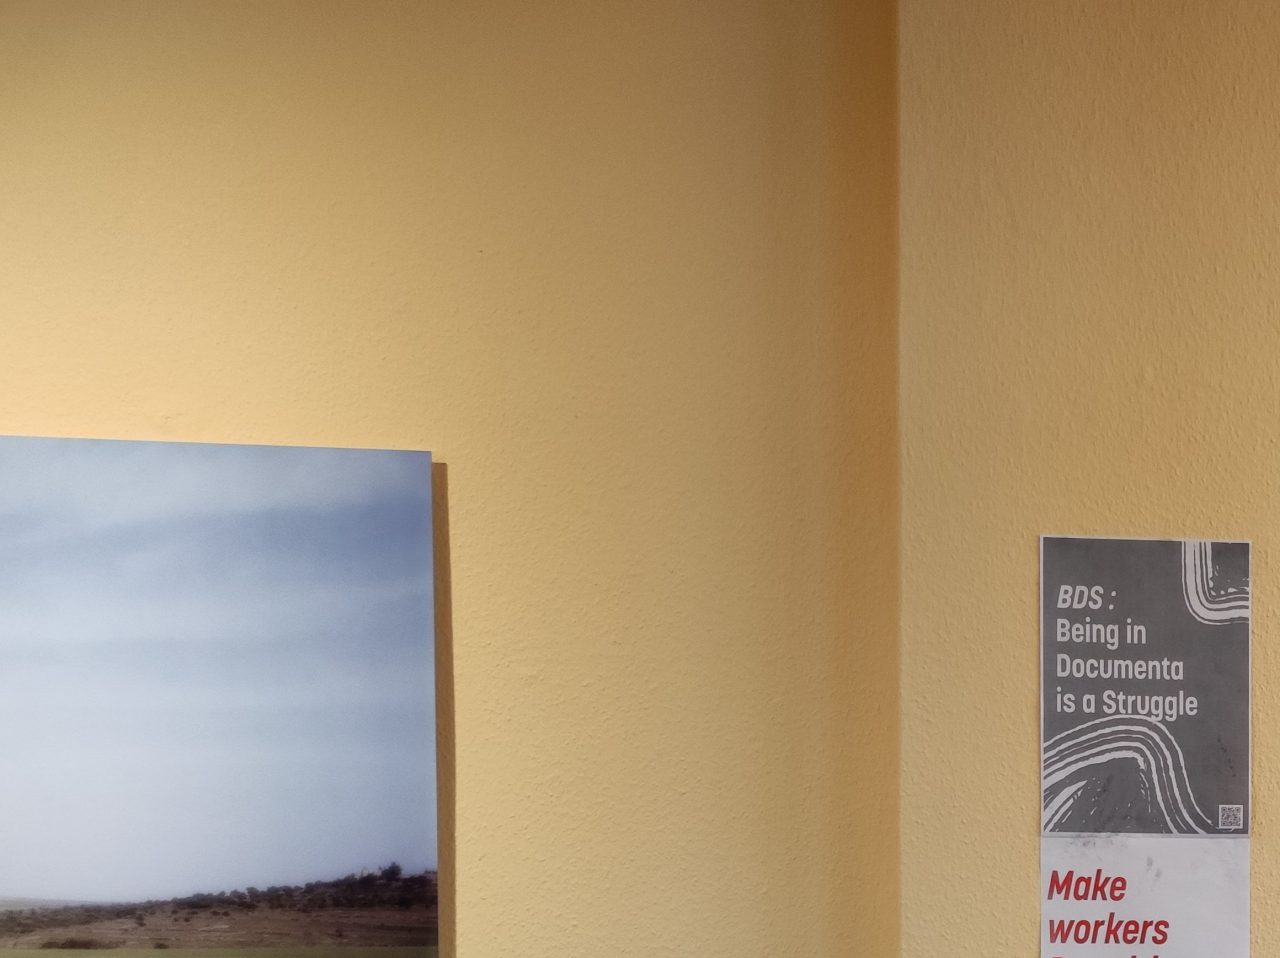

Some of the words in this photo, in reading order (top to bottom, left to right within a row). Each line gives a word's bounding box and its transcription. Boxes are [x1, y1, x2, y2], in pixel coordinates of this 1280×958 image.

[1056, 617, 1119, 650] Being
[1126, 617, 1147, 644] in
[1056, 653, 1184, 680] Documenta
[1056, 686, 1076, 713] is
[1082, 694, 1096, 713] a
[1102, 690, 1198, 722] Struggle
[1047, 868, 1127, 901] Make
[1048, 912, 1170, 945] workers
